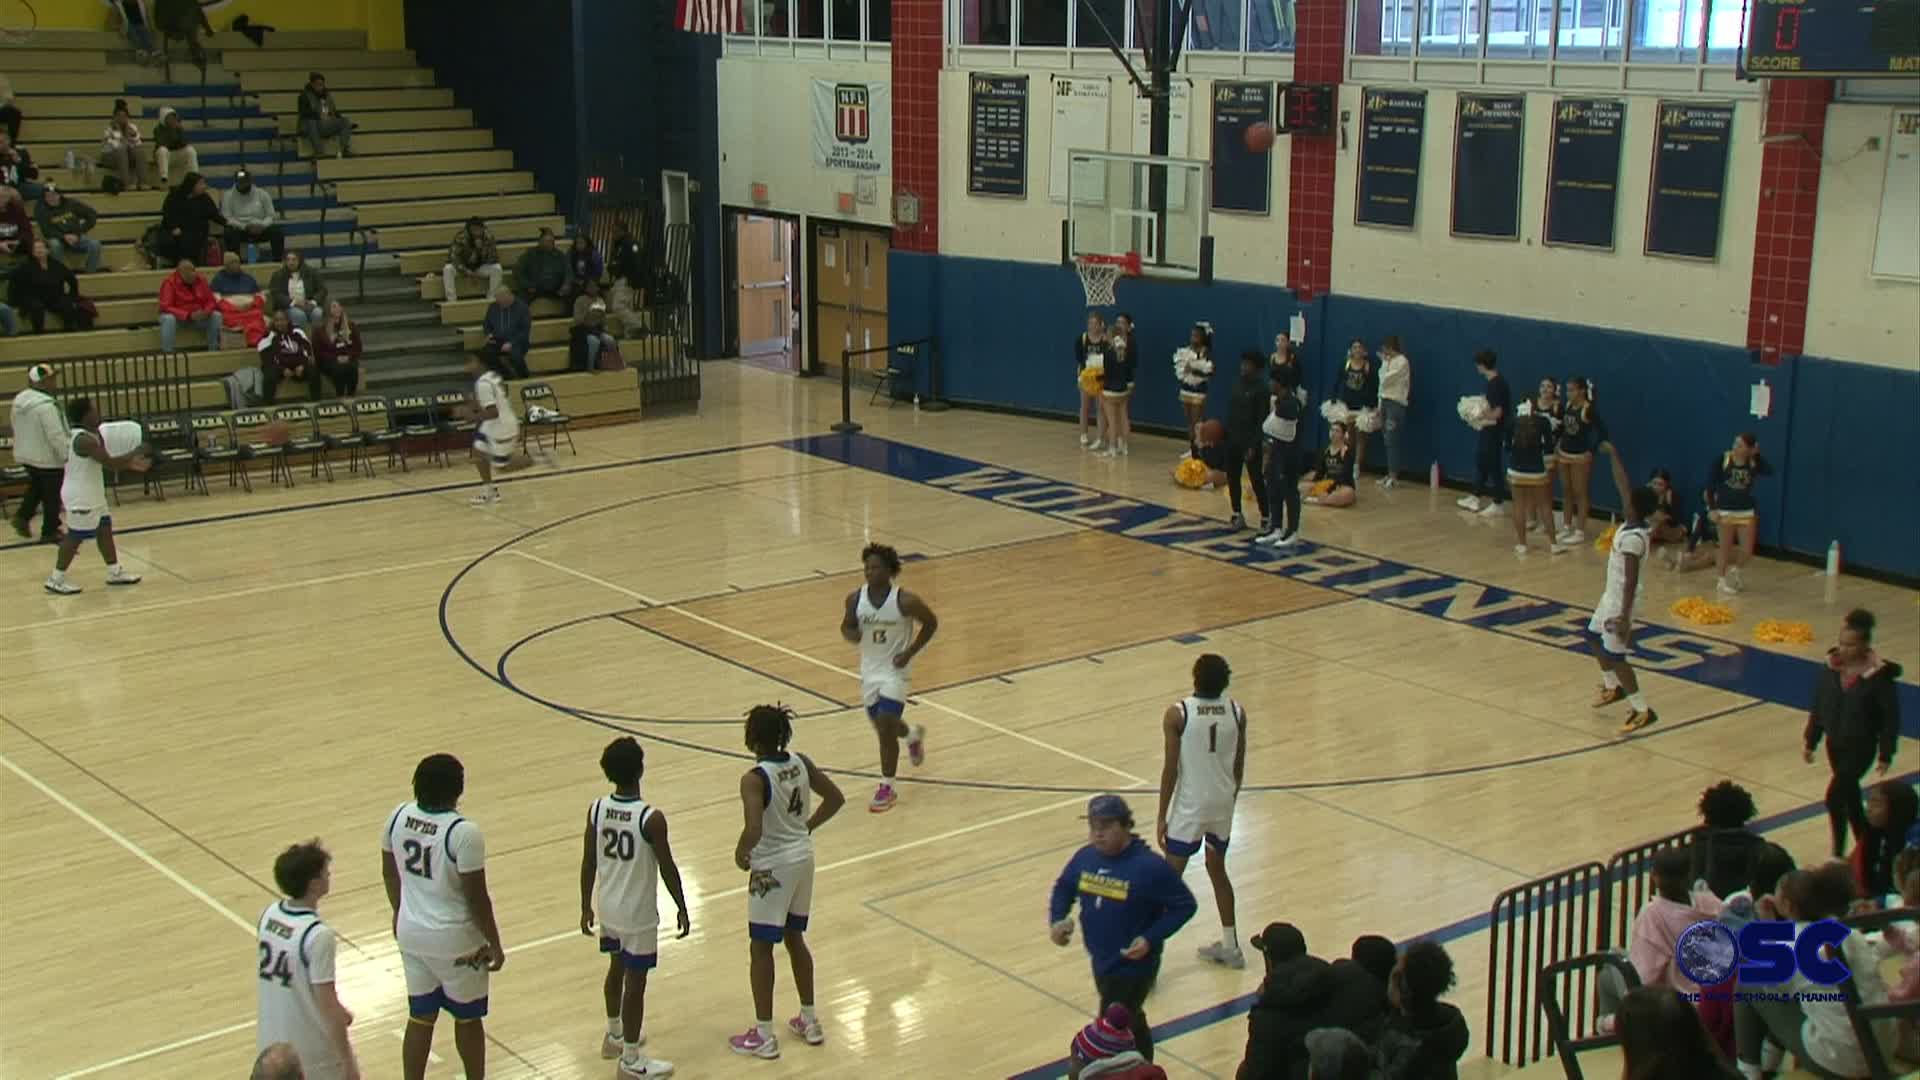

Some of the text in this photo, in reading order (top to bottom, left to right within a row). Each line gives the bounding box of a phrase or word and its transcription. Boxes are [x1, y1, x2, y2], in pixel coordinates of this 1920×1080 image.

[1751, 56, 1800, 70] SCORE
[840, 90, 865, 104] NFL
[1056, 81, 1072, 96] NF
[1388, 99, 1423, 108] BASEBALL
[825, 157, 881, 170] SPORTSMANSHIP
[1208, 721, 1217, 754] 1
[787, 786, 804, 817] 4
[606, 808, 632, 822] NFHS
[405, 816, 439, 836] NFHS
[602, 828, 635, 862] 20
[402, 839, 433, 880] 21
[259, 940, 293, 988] 24
